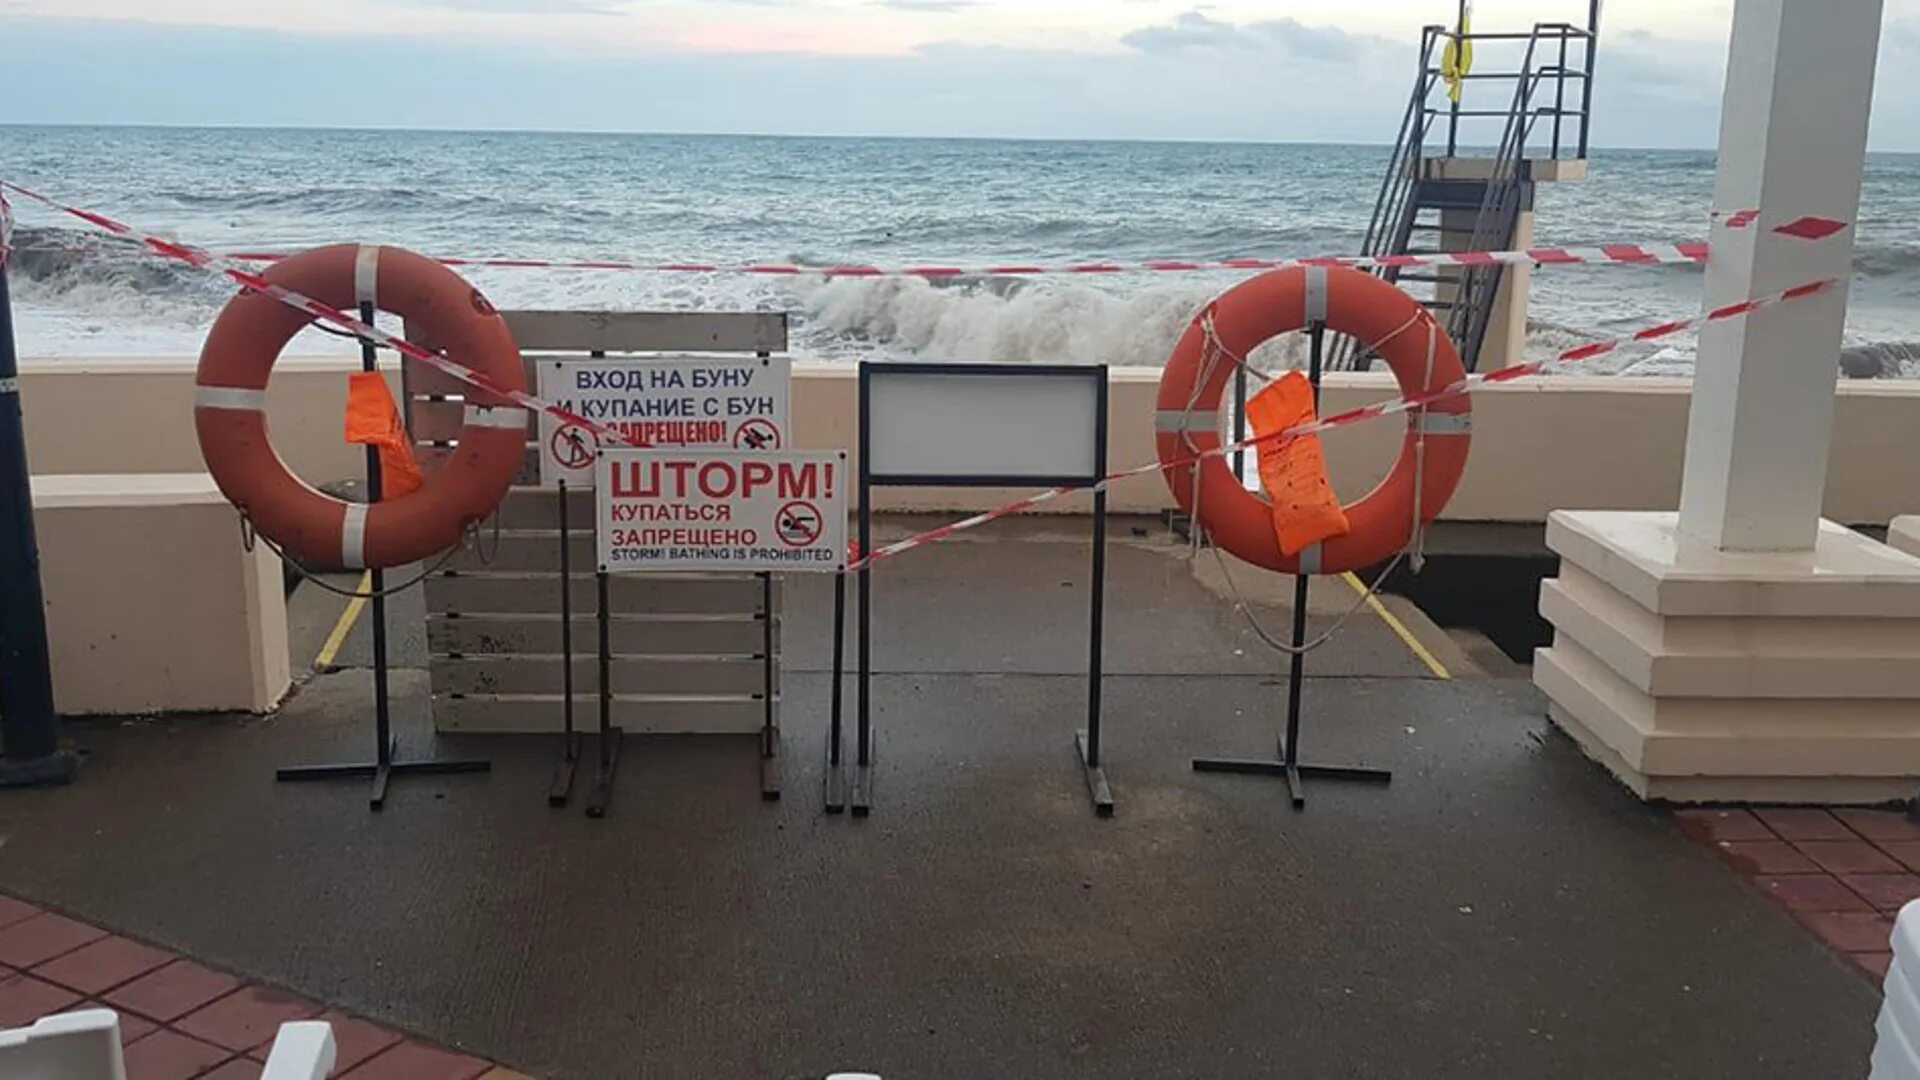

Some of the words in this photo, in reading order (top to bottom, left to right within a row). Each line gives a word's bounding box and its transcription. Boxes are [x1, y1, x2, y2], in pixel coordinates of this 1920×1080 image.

[576, 371, 643, 391] ВХОД
[651, 370, 685, 388] НА
[692, 368, 755, 387] БУНУ
[582, 399, 695, 417] КУПАНИЕ
[703, 398, 718, 416] С
[728, 397, 773, 415] БУН
[611, 461, 833, 499] ШТОРМ!
[611, 504, 731, 522] КУПАТЬСЯ
[611, 529, 757, 547] ЗАПРЕЩЕНО
[611, 549, 665, 561] STORM!
[669, 549, 729, 560] BATHING
[734, 549, 746, 560] IS
[750, 549, 833, 561] PROHIBITED
